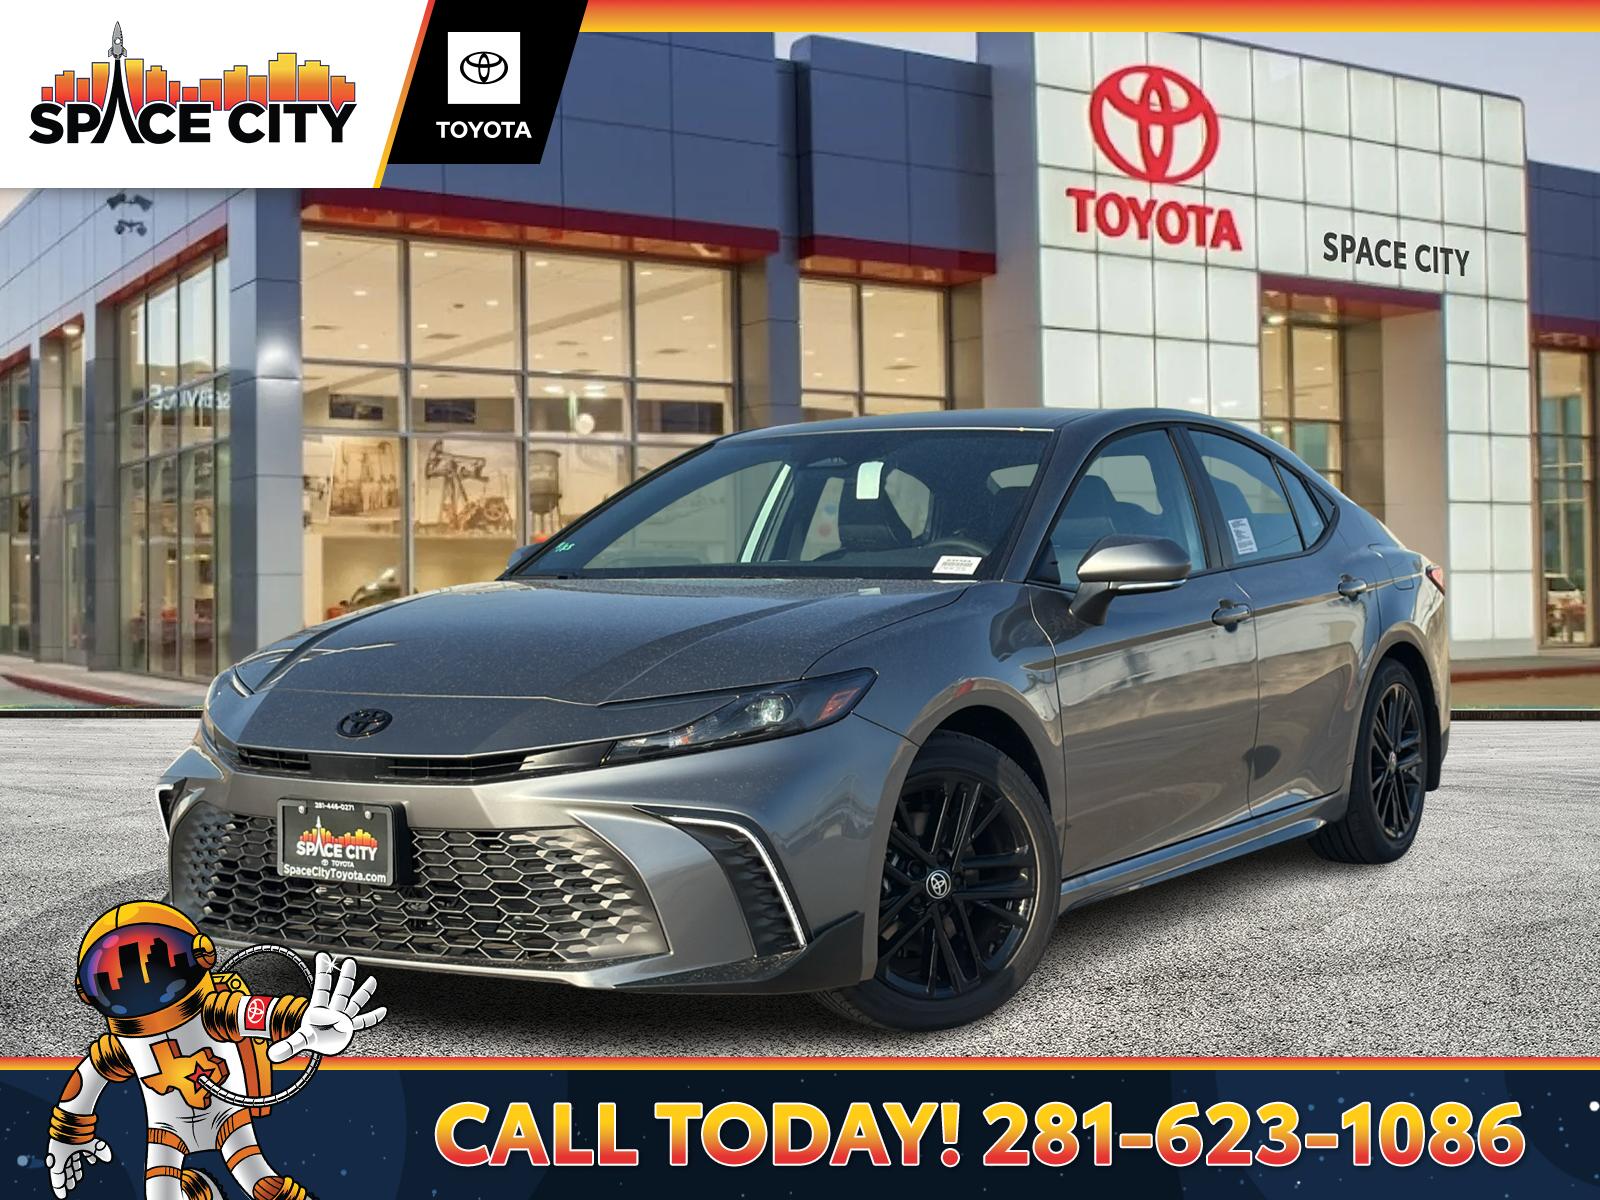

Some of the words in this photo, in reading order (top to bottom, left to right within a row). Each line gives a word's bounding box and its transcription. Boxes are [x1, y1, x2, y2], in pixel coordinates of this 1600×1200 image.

[1065, 187, 1243, 251] TOYOTA
[1323, 231, 1407, 270] SPACE
[1414, 244, 1470, 277] CITY
[345, 844, 378, 861] CITY
[283, 863, 387, 883] SpaceCityToyota.com
[331, 860, 355, 868] TOYOTA
